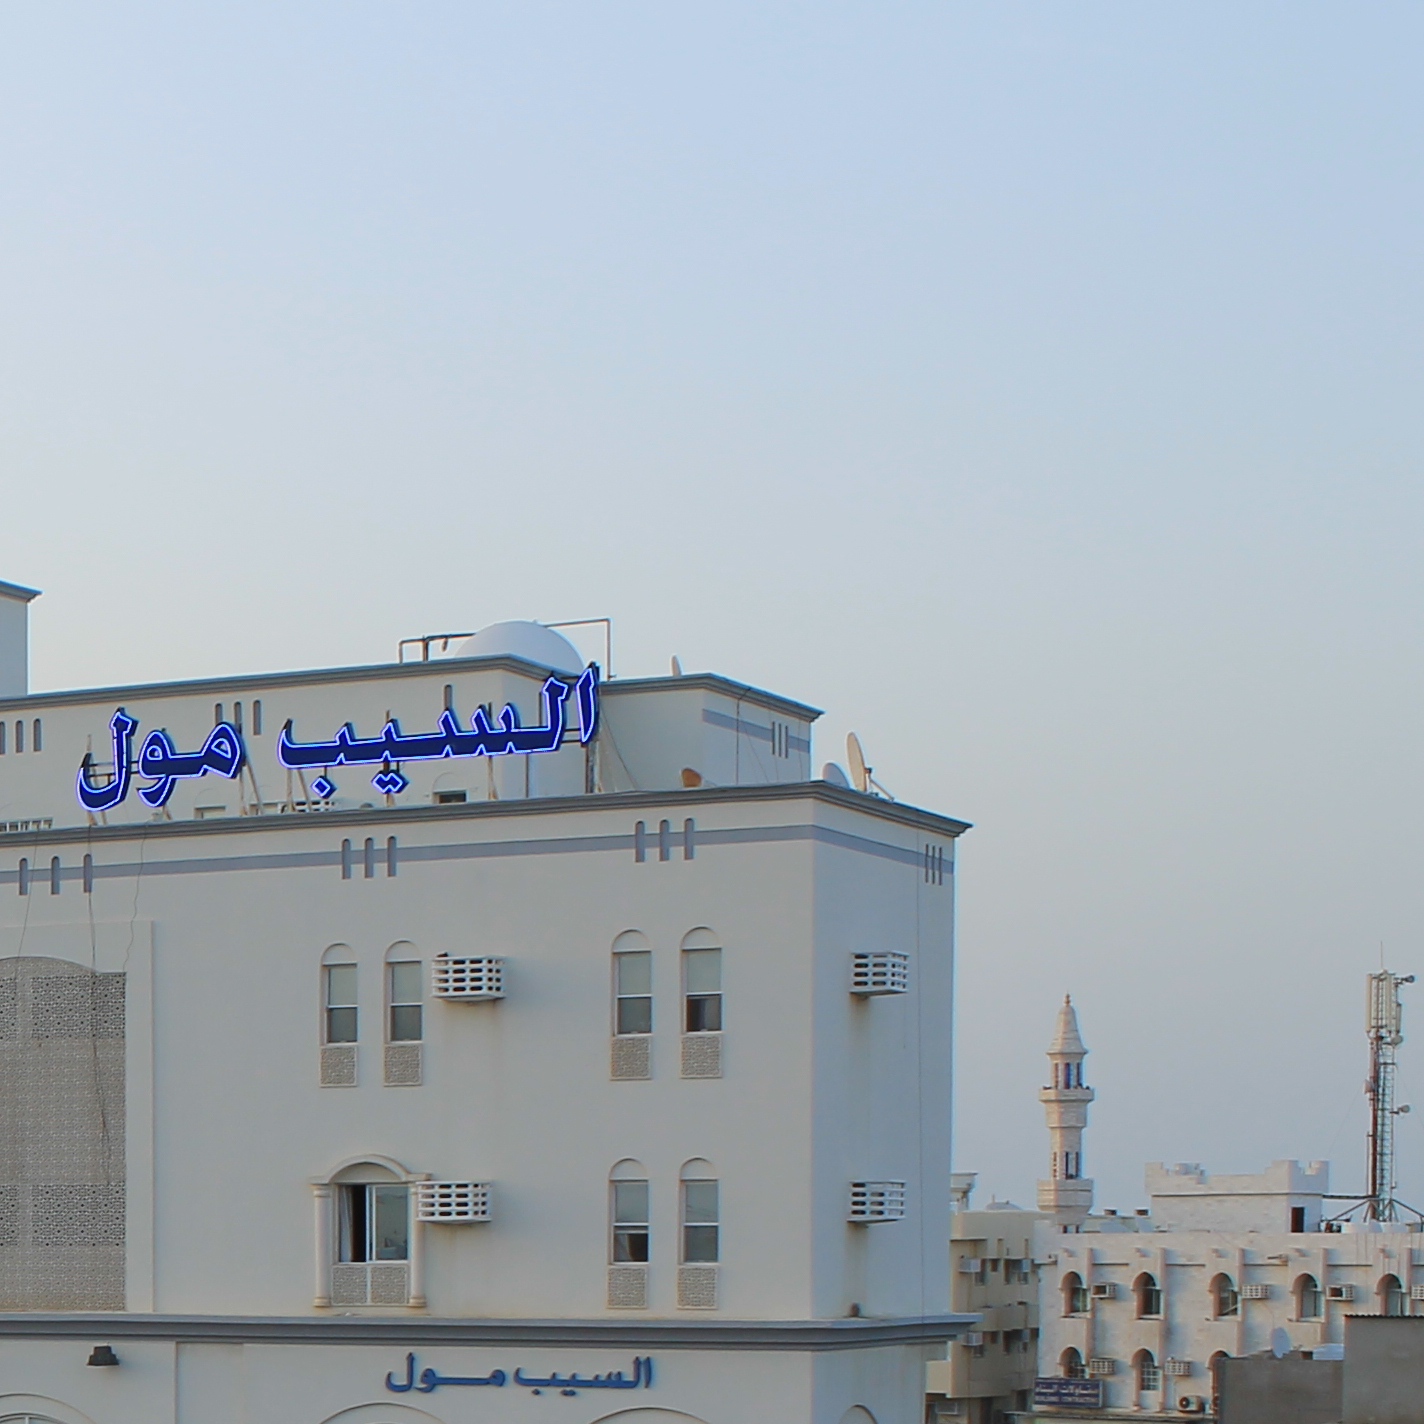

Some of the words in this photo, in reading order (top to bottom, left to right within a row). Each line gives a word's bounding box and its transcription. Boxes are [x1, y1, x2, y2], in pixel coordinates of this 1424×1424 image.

[77, 707, 246, 811] مول
[277, 662, 600, 798] السيب
[385, 1352, 506, 1393] مول
[513, 1356, 651, 1396] السيب
